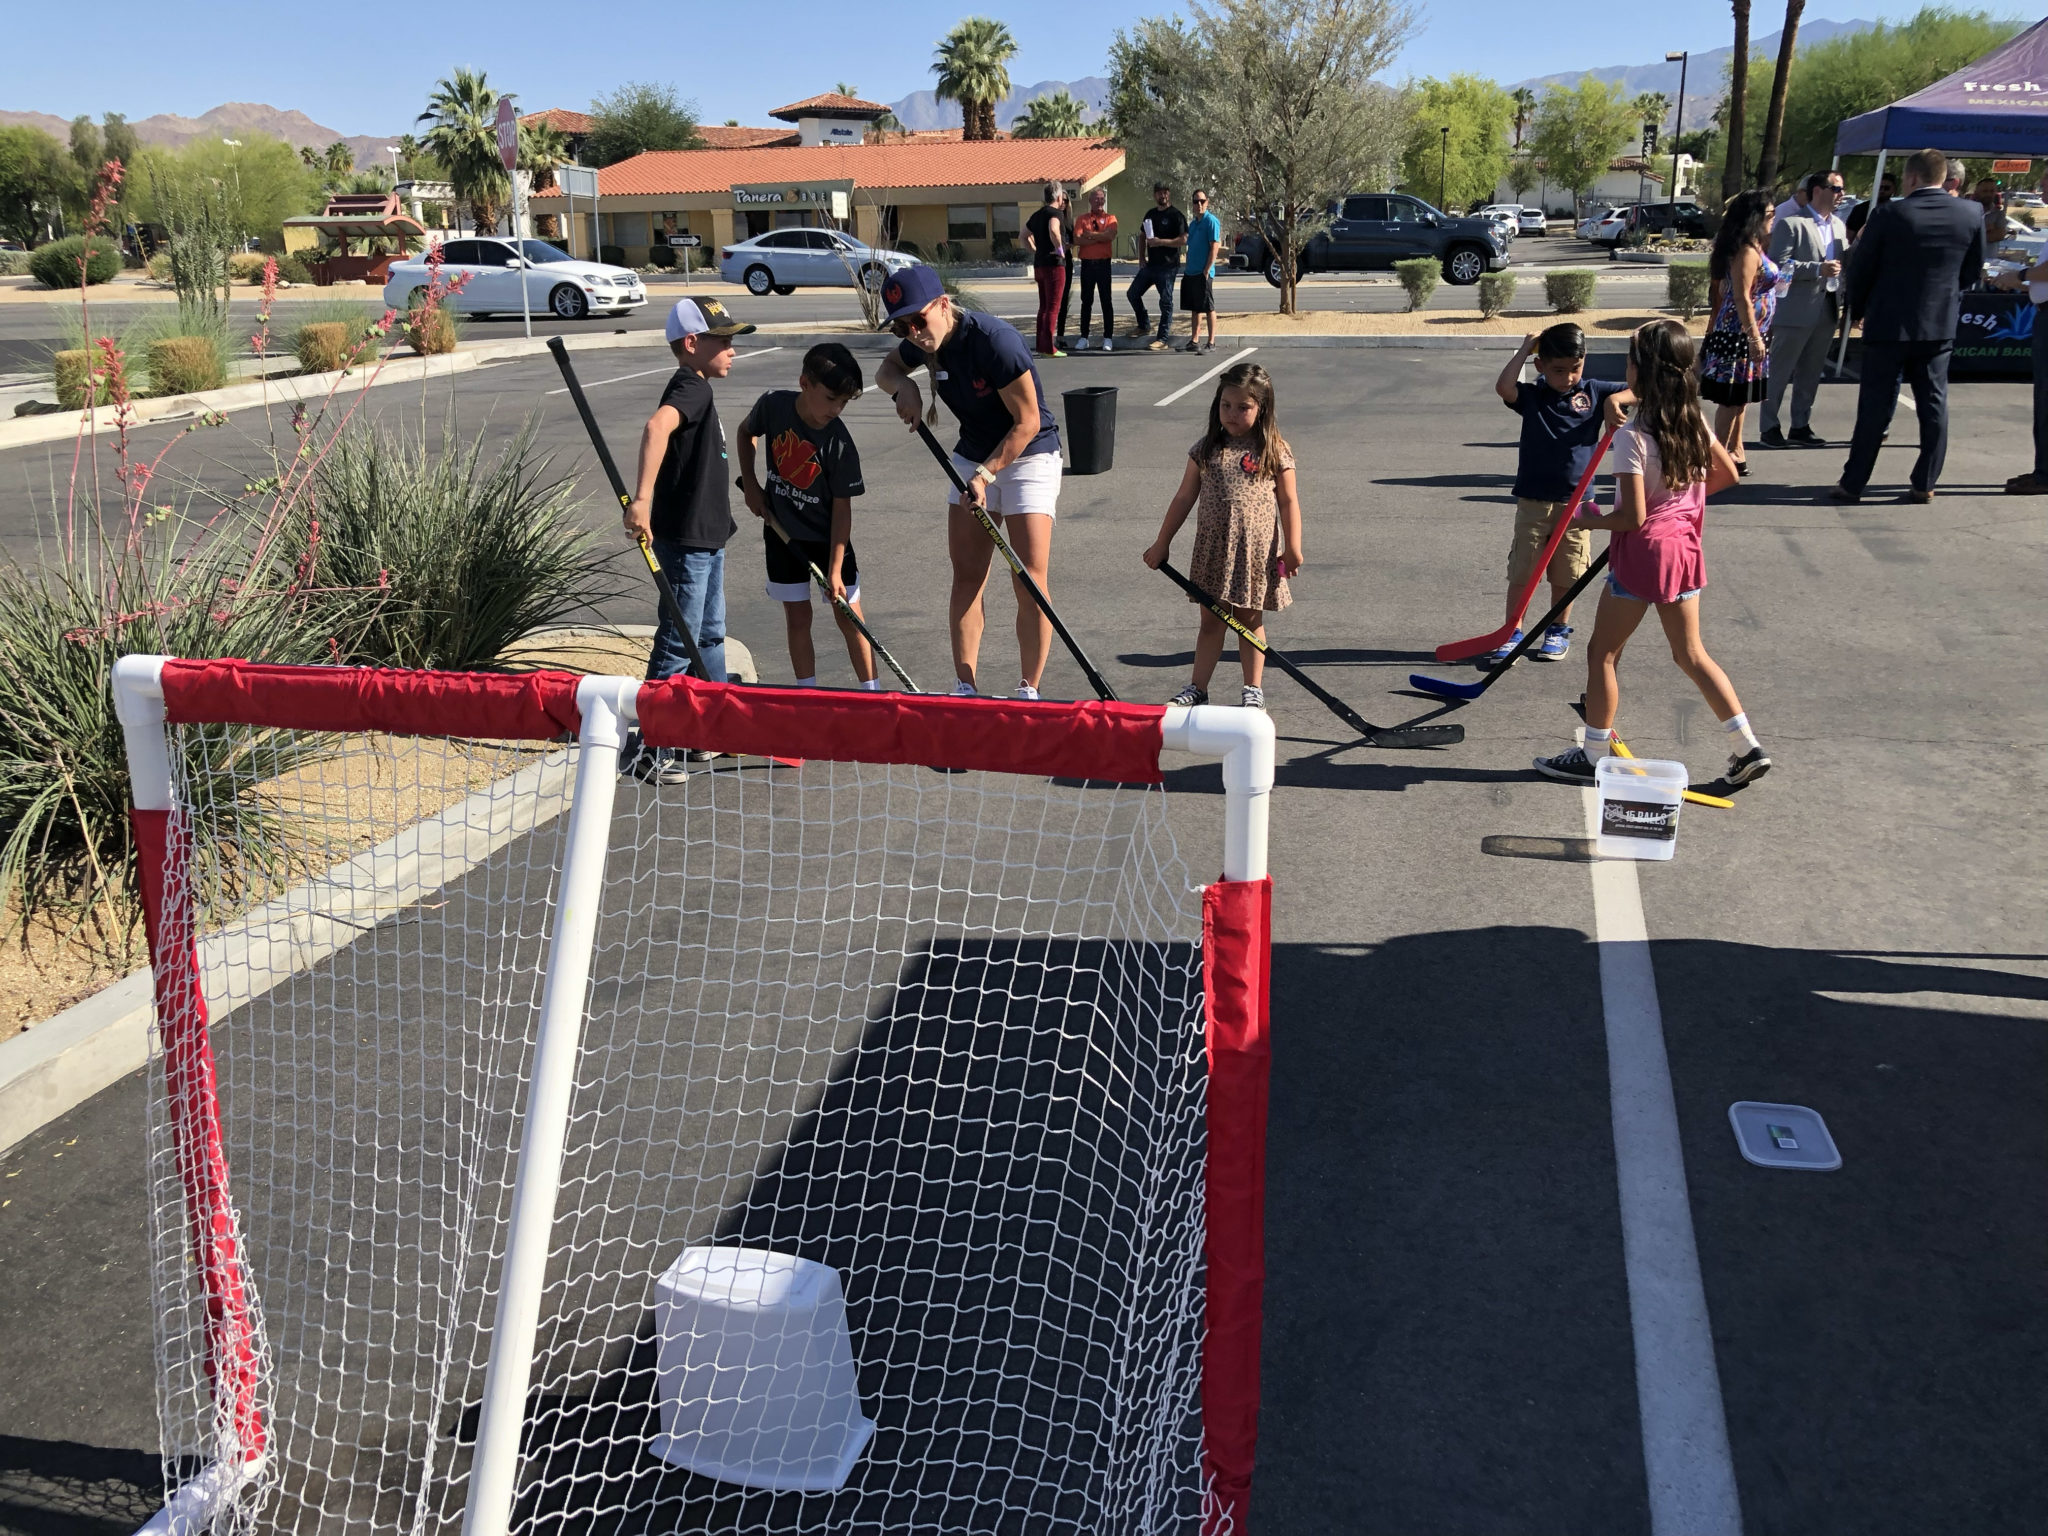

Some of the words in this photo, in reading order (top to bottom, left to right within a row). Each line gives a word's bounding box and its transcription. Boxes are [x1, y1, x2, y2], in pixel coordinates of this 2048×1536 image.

[498, 120, 515, 149] STOP
[831, 128, 853, 136] Allstate
[733, 189, 783, 203] Panera
[1961, 313, 1998, 330] esh
[1953, 347, 1999, 356] XICAN
[2002, 347, 2032, 356] BAR
[791, 487, 820, 504] blaze
[975, 508, 991, 529] ULTRA
[989, 528, 1006, 549] SHAFT
[1211, 604, 1230, 621] ULTRA
[1227, 617, 1247, 634] SHAFT
[1625, 810, 1636, 822] 15
[1637, 810, 1668, 825] BALLS
